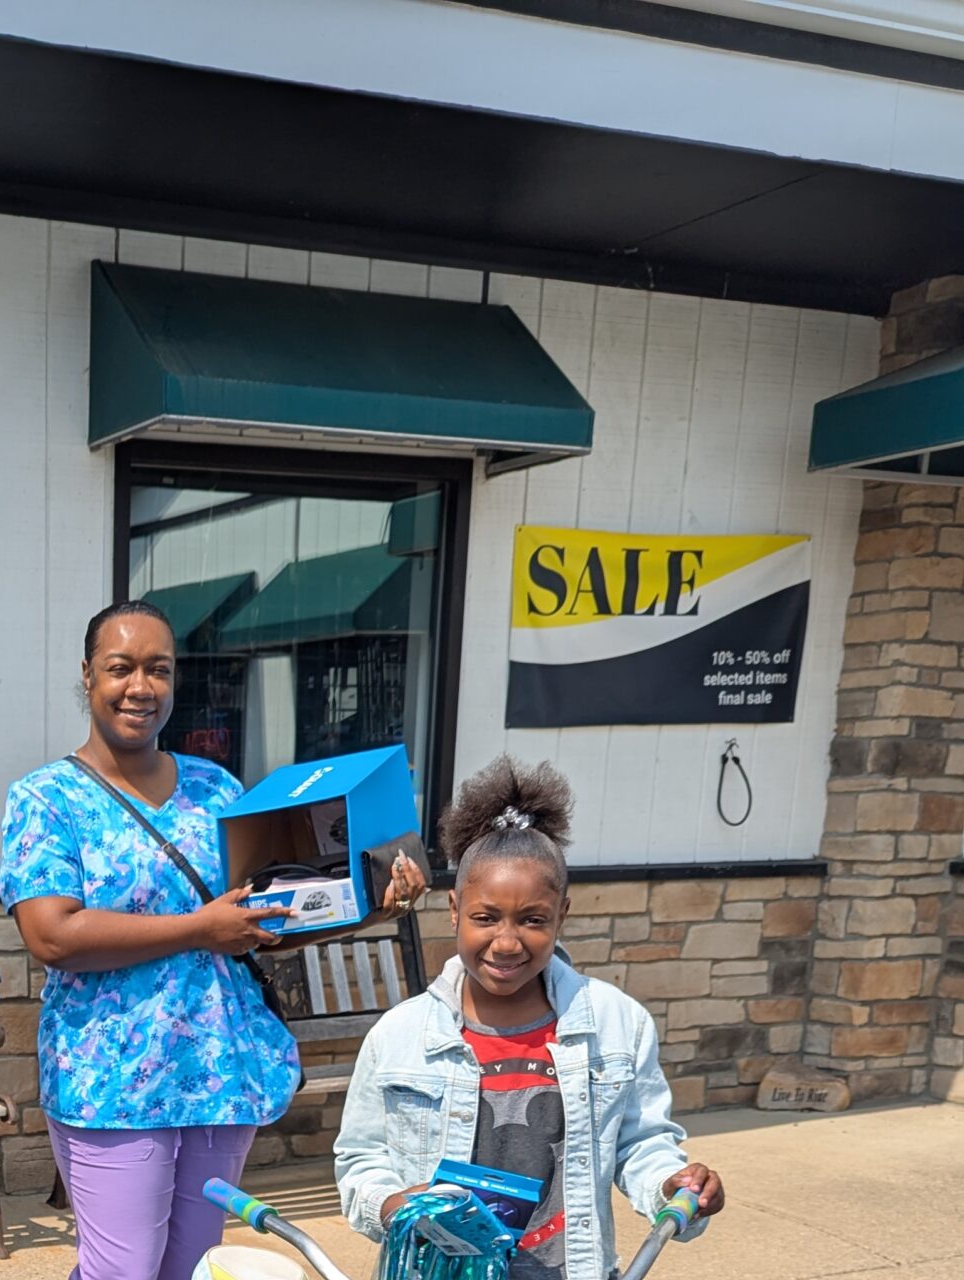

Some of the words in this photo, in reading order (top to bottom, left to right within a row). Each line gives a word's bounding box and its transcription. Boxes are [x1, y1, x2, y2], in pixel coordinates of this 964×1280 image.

[527, 544, 704, 616] SALE
[712, 651, 734, 665] 10%
[745, 651, 770, 664] 50%
[773, 649, 791, 664] off
[704, 671, 753, 686] selected
[756, 670, 788, 685] items
[719, 691, 745, 705] final
[747, 691, 773, 705] sale
